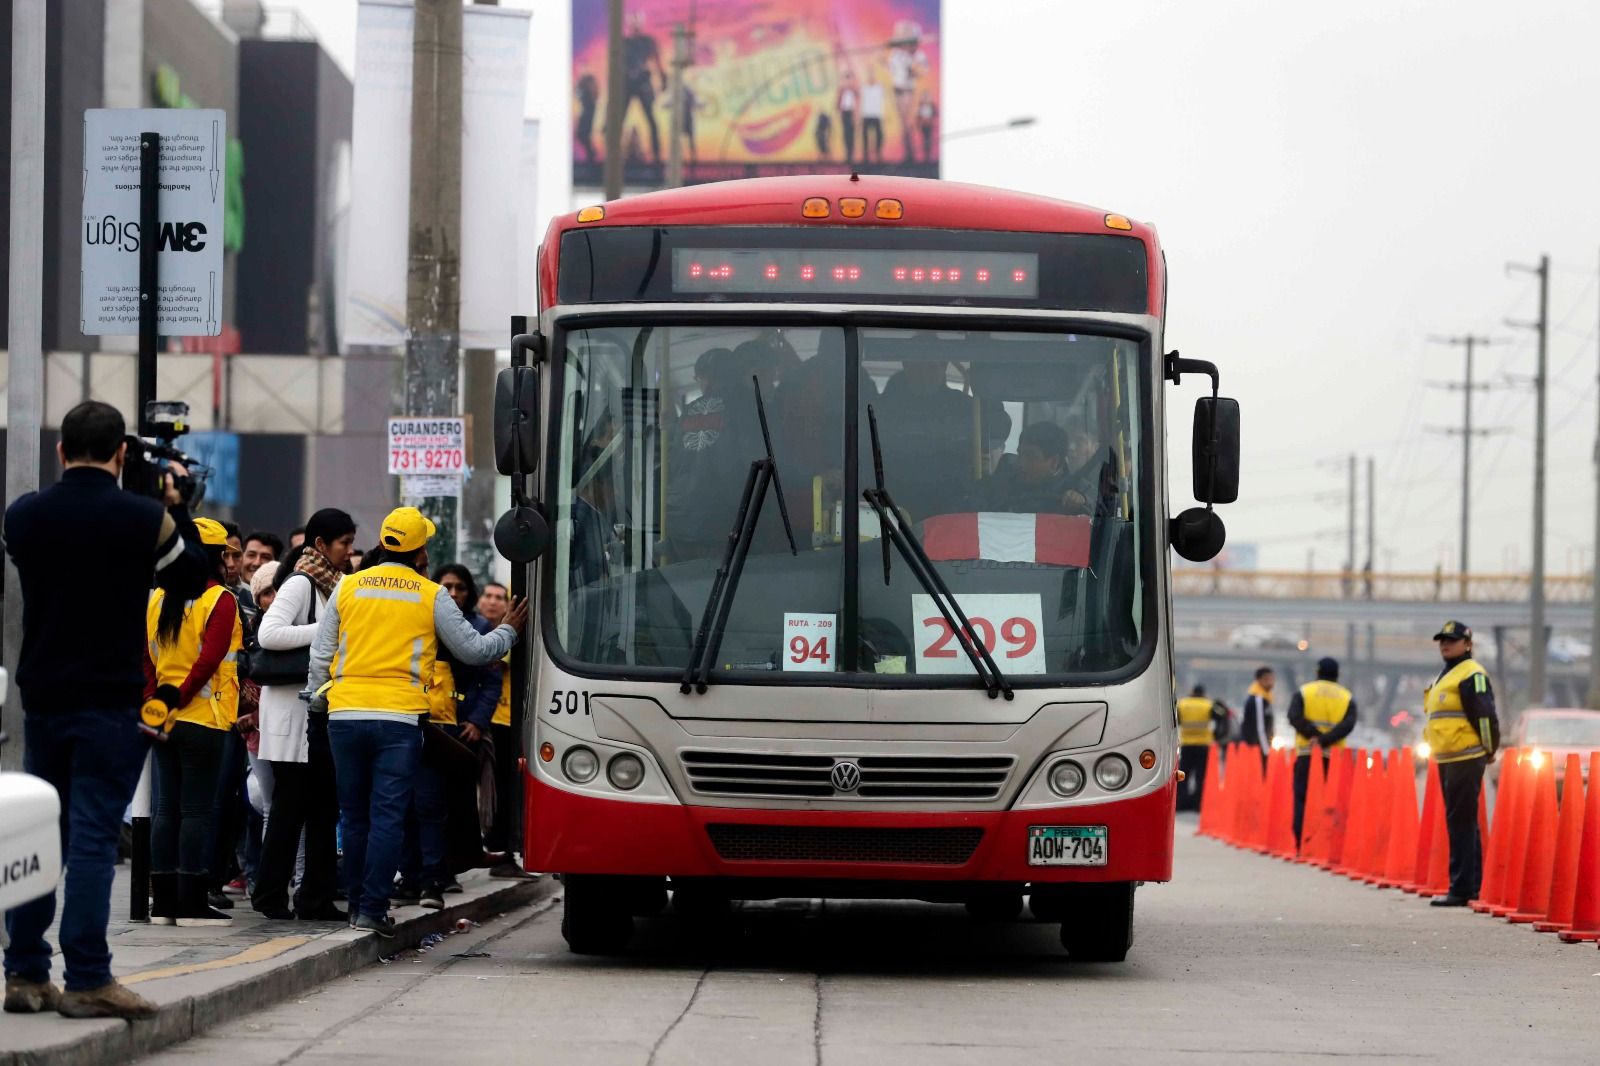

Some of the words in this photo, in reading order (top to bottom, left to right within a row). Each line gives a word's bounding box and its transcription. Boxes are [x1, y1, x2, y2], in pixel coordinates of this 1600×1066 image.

[171, 134, 199, 142] through
[178, 144, 205, 152] damage
[118, 154, 136, 162] edges
[158, 183, 191, 191] Handling
[86, 215, 140, 253] Sign
[157, 222, 207, 252] 3M
[168, 285, 196, 293] through
[174, 295, 202, 303] damage
[115, 305, 135, 313] edges
[391, 422, 461, 435] CURANDERO
[392, 450, 462, 469] 731-9270
[358, 576, 421, 591] ORIENTADOR
[788, 620, 809, 628] RUTA
[817, 620, 832, 628] 209
[922, 616, 1037, 659] 209
[789, 635, 830, 665] 94
[548, 690, 590, 716] 501
[0, 853, 41, 887] ICIA
